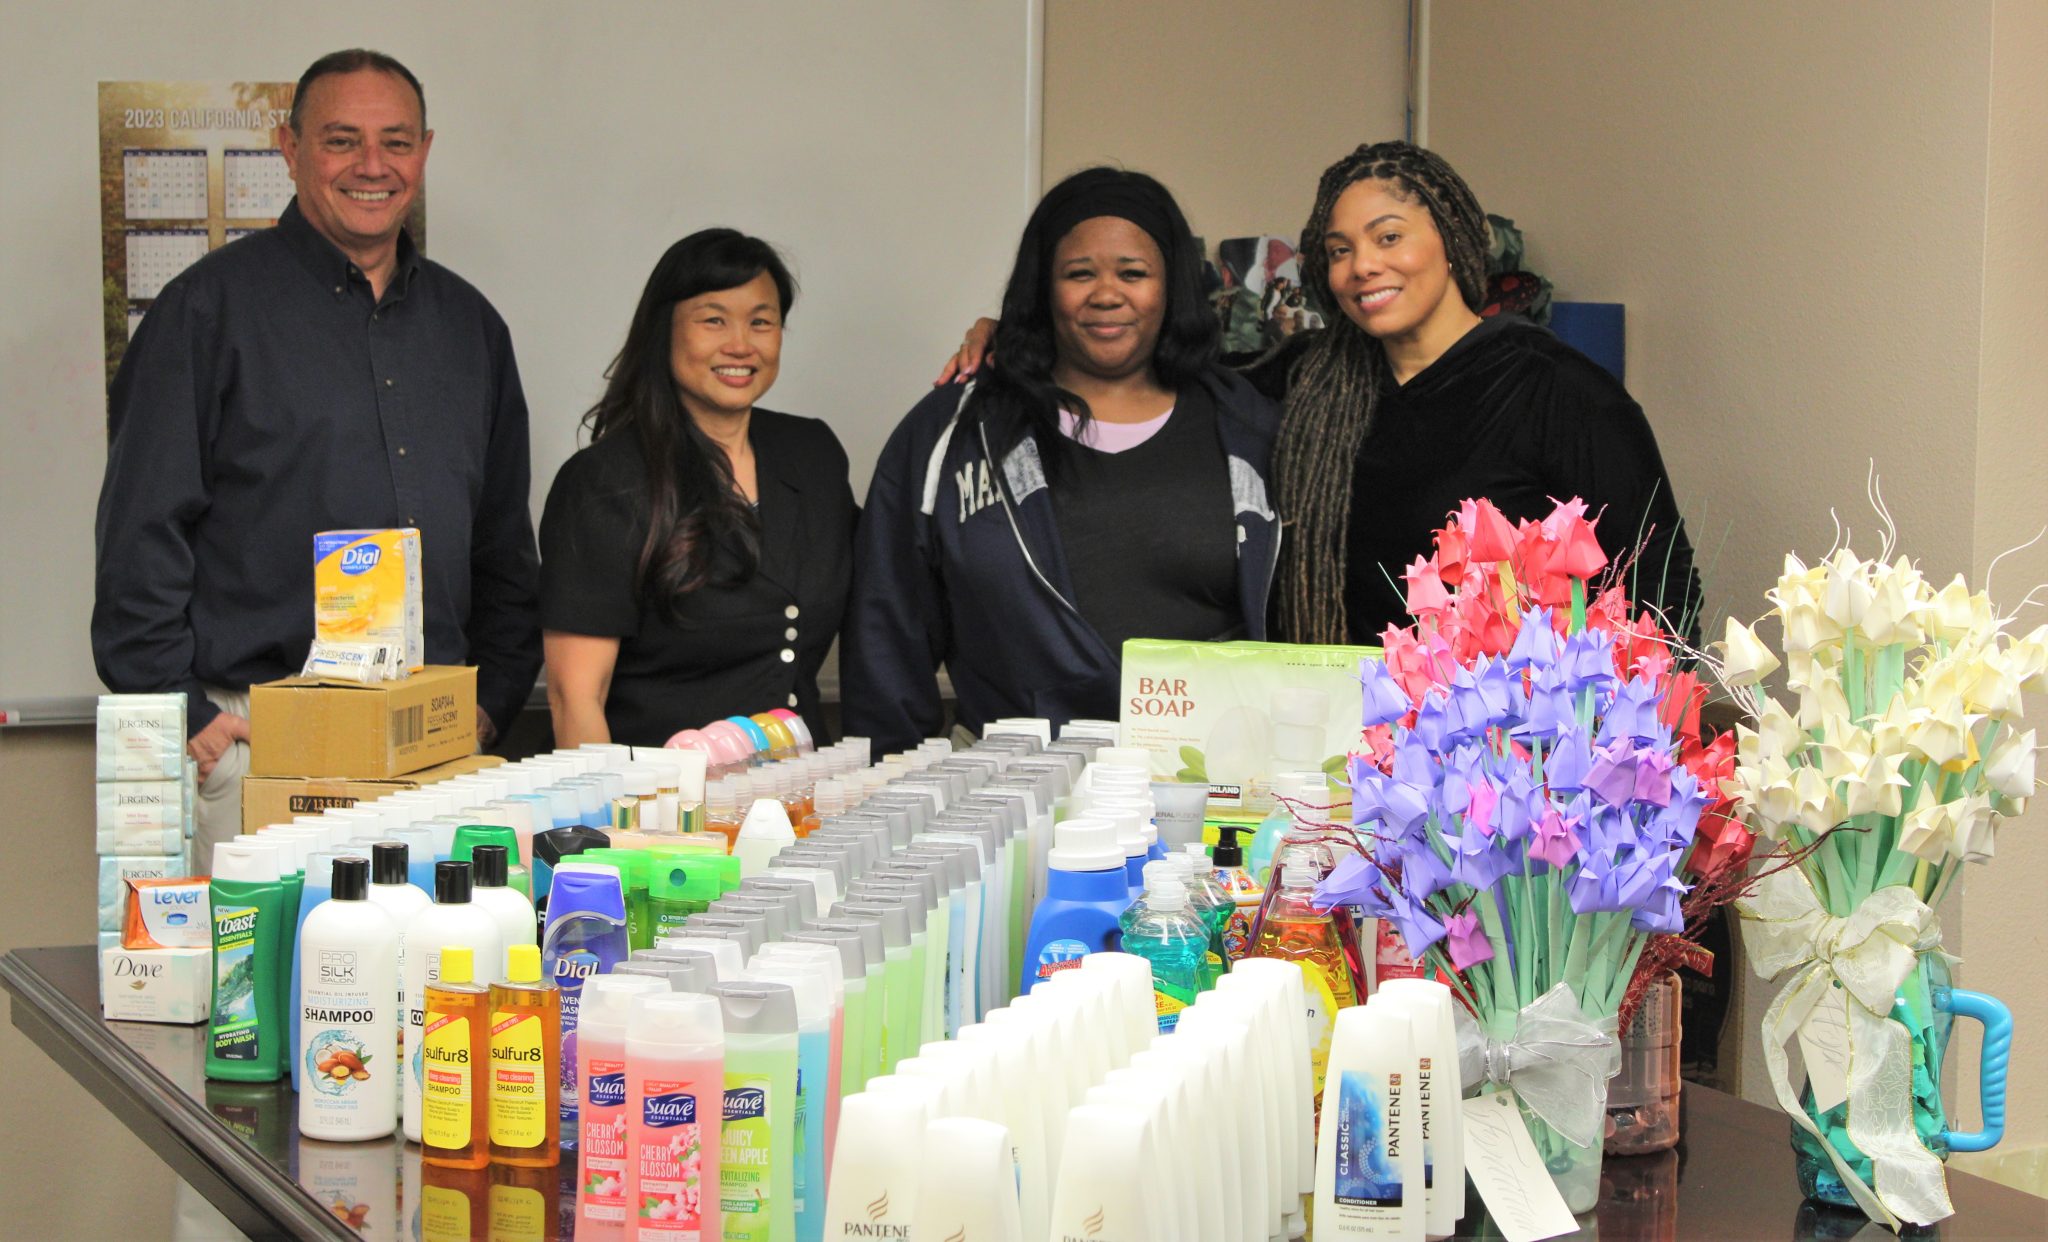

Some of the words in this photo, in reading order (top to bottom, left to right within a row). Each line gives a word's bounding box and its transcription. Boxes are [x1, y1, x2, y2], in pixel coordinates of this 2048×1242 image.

[125, 109, 164, 128] 2023
[170, 109, 262, 129] CALIFORNIA
[268, 109, 293, 128] ST
[955, 459, 1002, 523] MA
[342, 548, 381, 565] Dial
[1139, 677, 1188, 696] BAR
[1130, 697, 1195, 717] SOAP
[118, 718, 161, 729] JERGENS
[118, 794, 161, 806] JERGENS
[122, 868, 164, 880] JERGENS
[154, 888, 203, 905] Lever
[218, 912, 256, 936] Coast
[219, 930, 253, 943] ESSENTIALS
[112, 955, 163, 978] Dove
[321, 951, 355, 965] PRO
[320, 965, 355, 977] SILK
[554, 958, 600, 979] Dial
[308, 996, 369, 1006] MOISTURIZING
[304, 1007, 374, 1023] SHAMPOO
[215, 1038, 233, 1048] BODY
[233, 1032, 255, 1044] WASH
[425, 1047, 468, 1063] sulfur8
[492, 1047, 541, 1062] sulfur8
[428, 1083, 461, 1095] SHAMPOO
[496, 1083, 535, 1094] SHAMPOO
[590, 1077, 625, 1095] Suav
[644, 1097, 694, 1116] Suave
[723, 1096, 762, 1110] uave
[586, 1121, 616, 1140] CHERRY
[1388, 1087, 1401, 1157] PANTENE
[724, 1129, 753, 1146] JUICY
[586, 1138, 624, 1156] BLOSSOM
[640, 1143, 672, 1162] CHERRY
[1340, 1123, 1350, 1175] CLASSIC
[721, 1149, 738, 1164] EEN
[740, 1148, 769, 1165] APPLE
[640, 1160, 680, 1178] BLOSSOM
[721, 1170, 760, 1182] EVITALIZING
[1339, 1197, 1377, 1206] CONDITIONER
[844, 1221, 911, 1240] PANTENE
